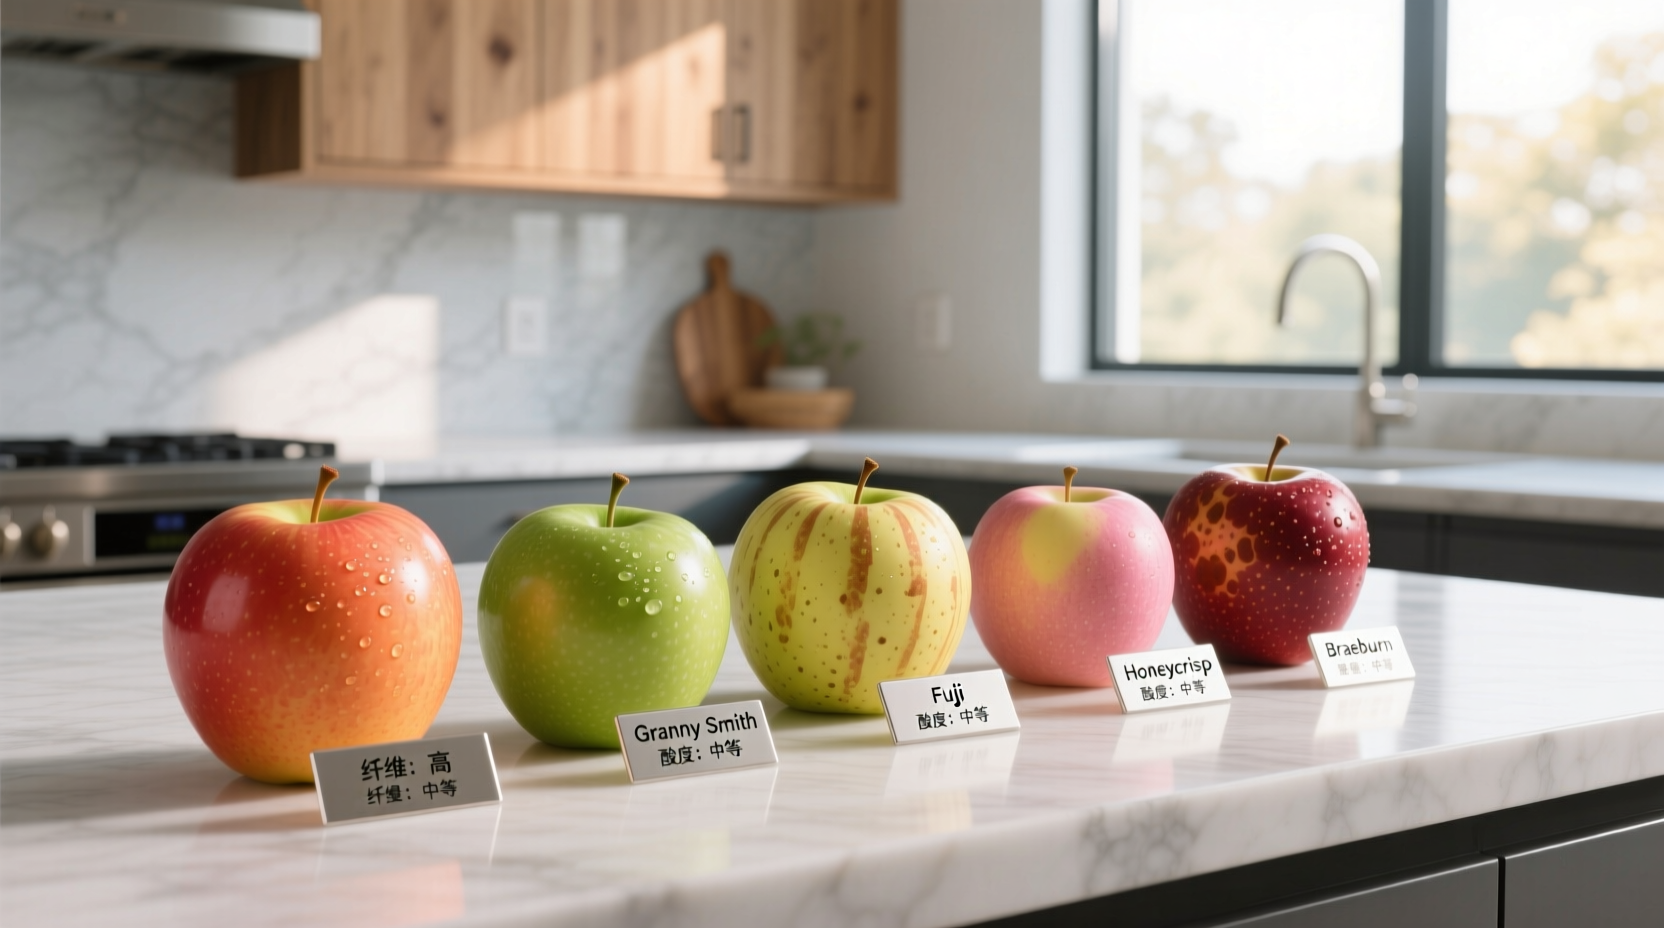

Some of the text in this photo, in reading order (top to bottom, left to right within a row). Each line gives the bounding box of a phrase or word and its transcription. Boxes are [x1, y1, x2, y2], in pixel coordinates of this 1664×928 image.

[1325, 637, 1393, 657] Braeburn
[1123, 656, 1212, 681] Honeycrisp
[931, 683, 965, 708] Fuji
[634, 711, 758, 742] Granny Smith
